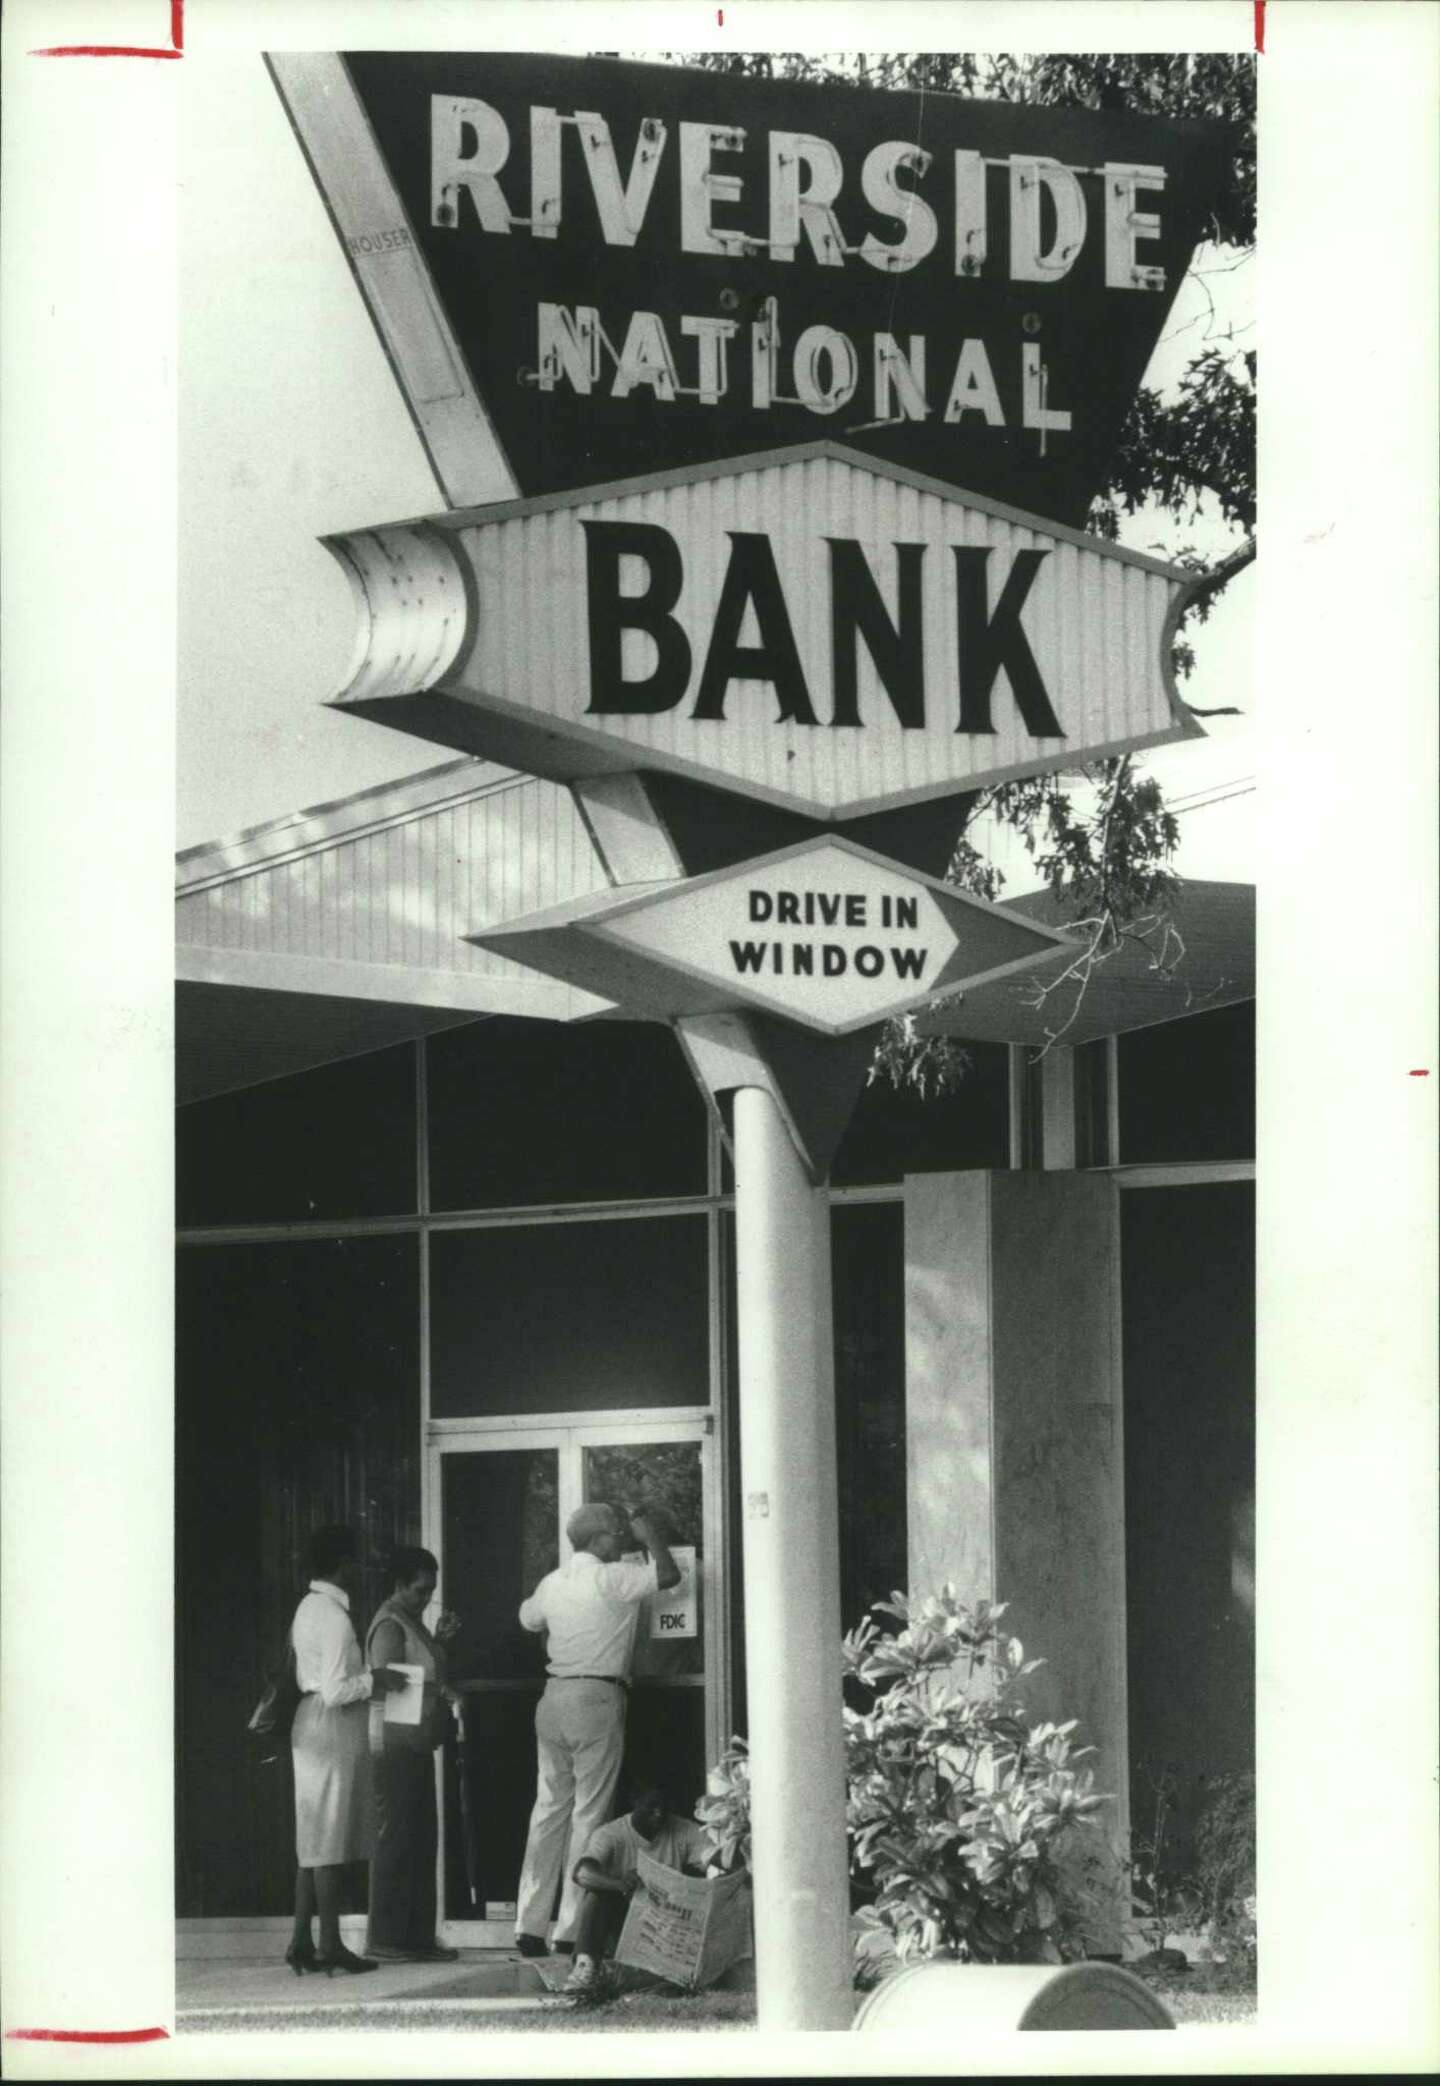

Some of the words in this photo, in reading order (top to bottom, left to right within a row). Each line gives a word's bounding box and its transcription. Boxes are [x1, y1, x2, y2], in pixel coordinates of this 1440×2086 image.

[429, 94, 1167, 292] RIVERSIDE
[536, 300, 1072, 432] NATIONAL
[580, 519, 1067, 738] BANK
[750, 890, 867, 927] DRIVE
[882, 895, 918, 928] IN
[729, 940, 928, 979] WINDOW
[660, 1613, 686, 1629] FDIC
